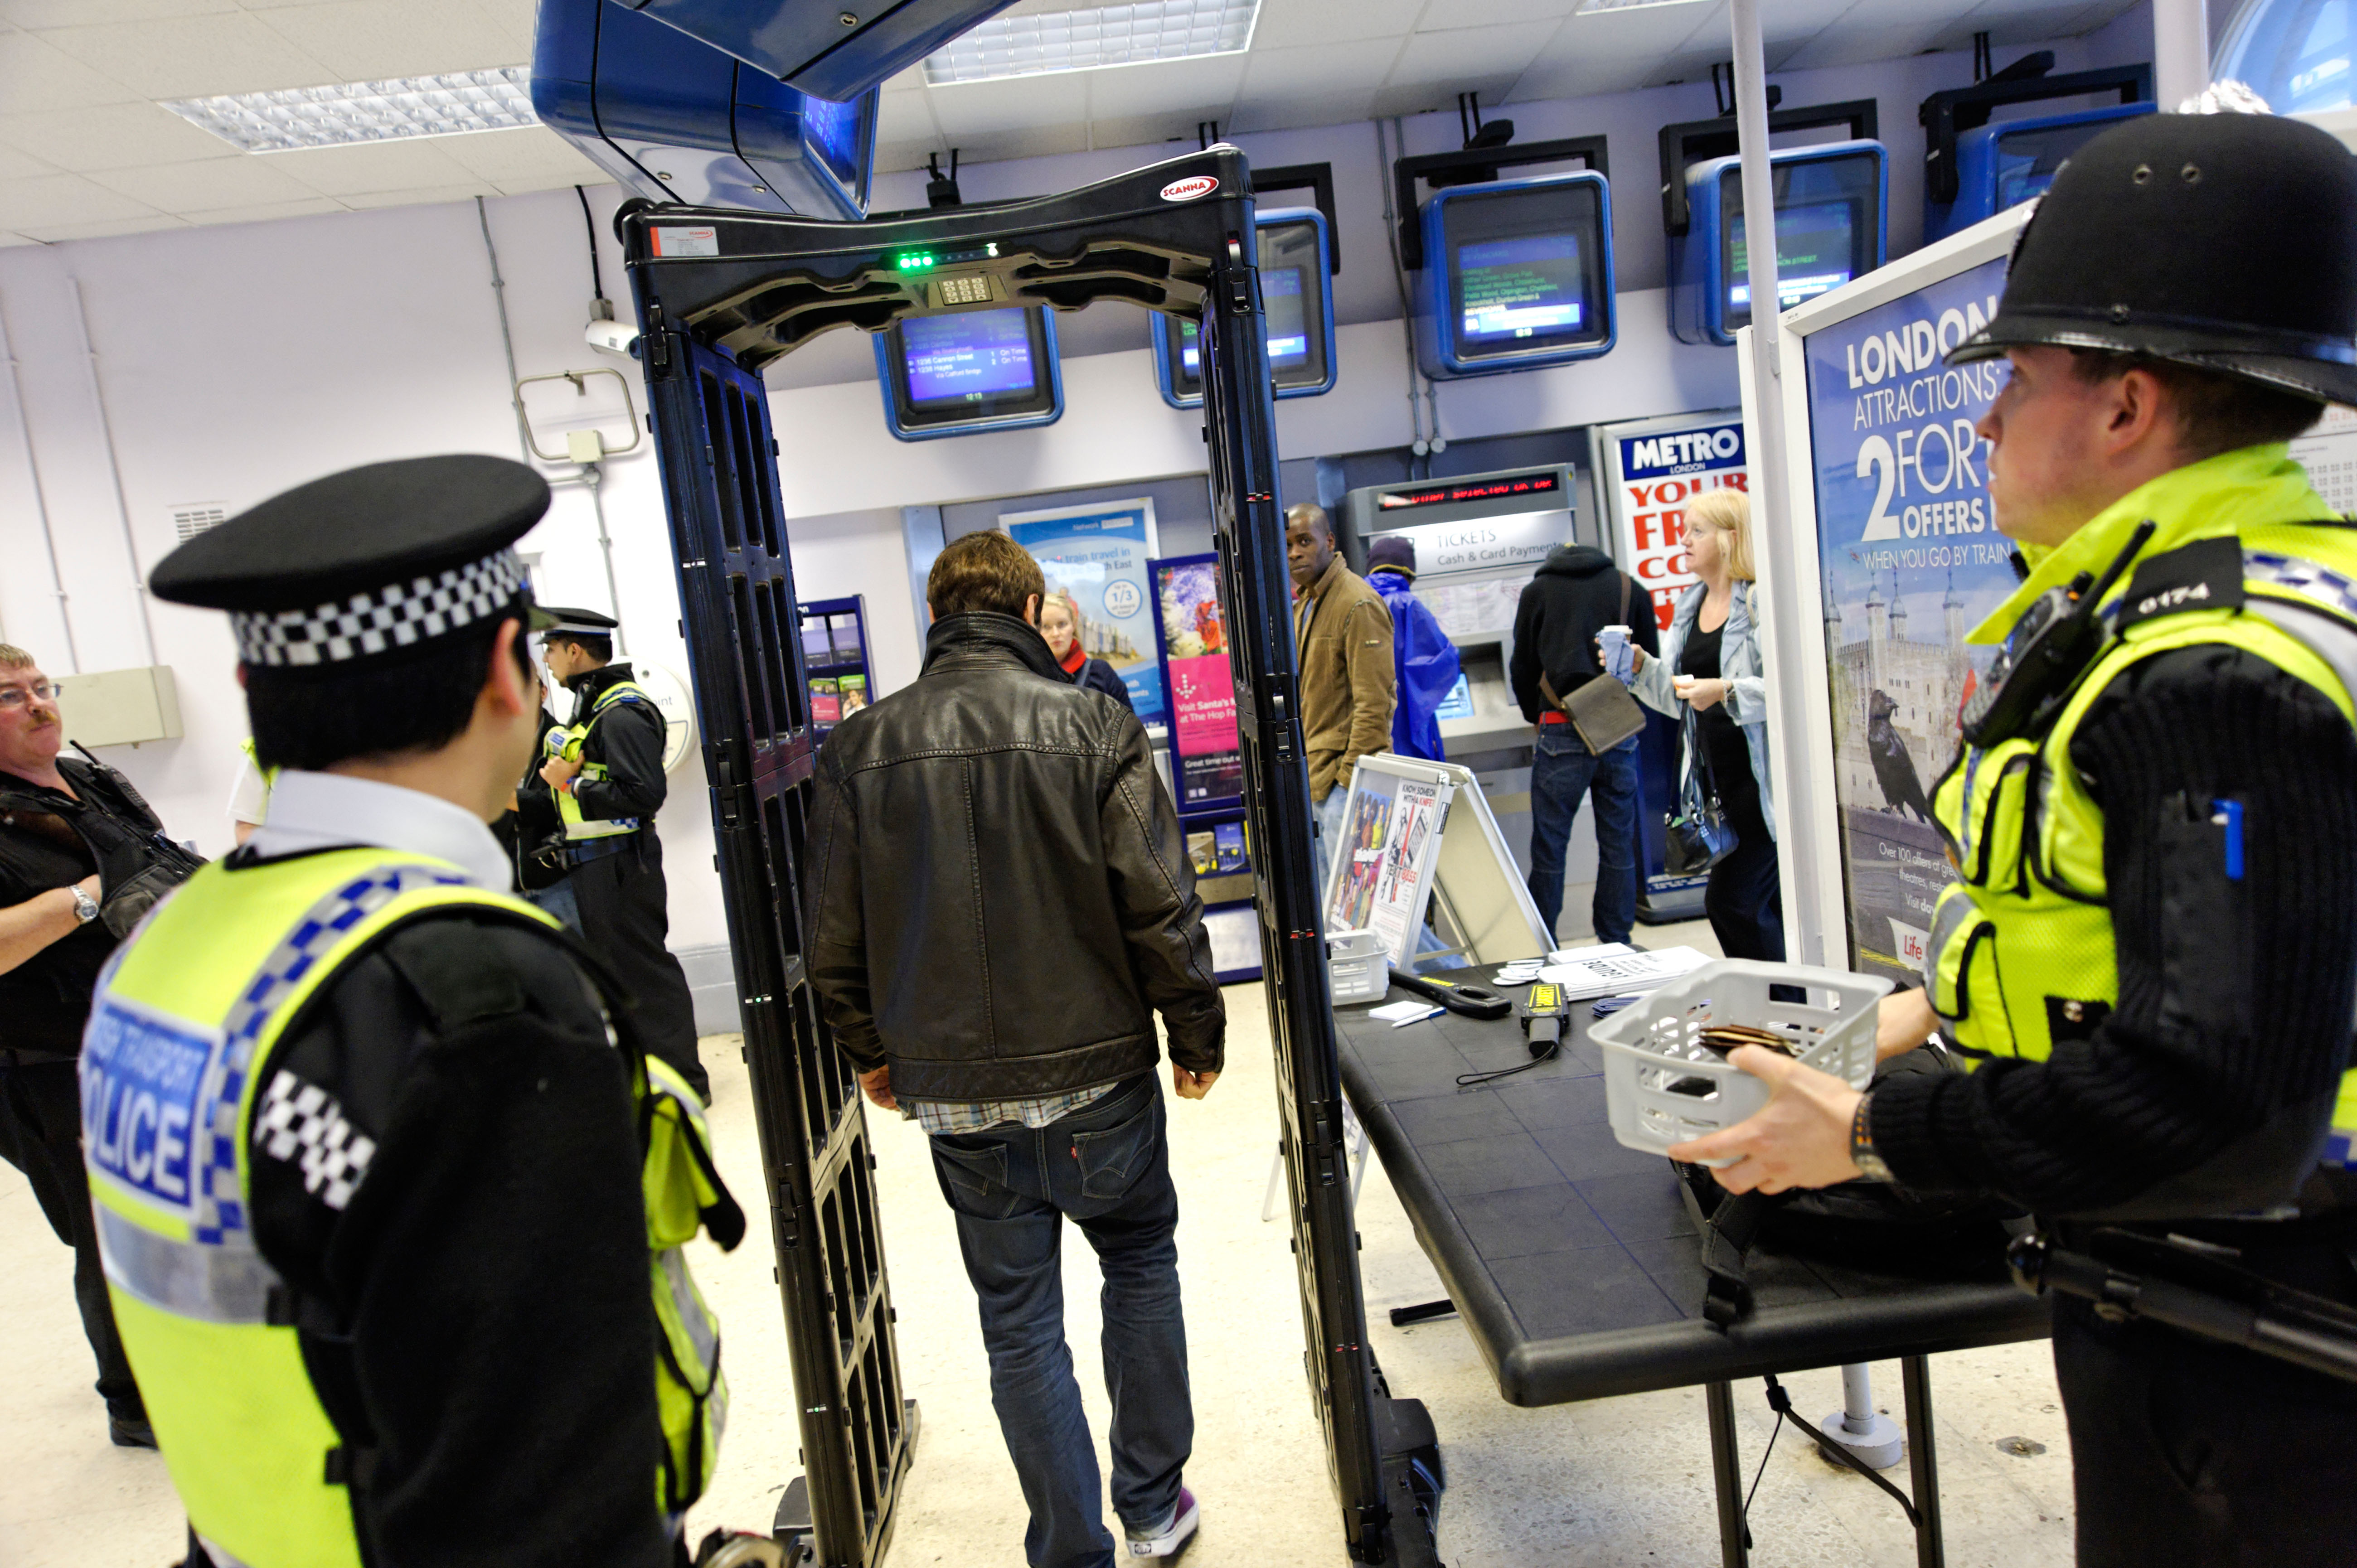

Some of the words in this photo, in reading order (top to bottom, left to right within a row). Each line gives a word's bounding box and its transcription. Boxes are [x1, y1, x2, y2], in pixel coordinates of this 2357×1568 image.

[1164, 182, 1206, 196] SCANNA
[1853, 361, 2002, 431] ATTRACTIONS:
[1633, 428, 1740, 471] METRO
[1669, 462, 1706, 475] LONDON
[1857, 435, 1901, 542] 2
[1896, 418, 1981, 497] FOR
[1903, 498, 1985, 539] OFFERS
[1437, 528, 1497, 548] TICKETS
[1633, 509, 1686, 551] FR
[1066, 554, 1088, 563] train
[1091, 547, 1119, 560] travel
[1121, 547, 1131, 557] in
[1114, 560, 1133, 570] East
[1438, 551, 1465, 566] Cash
[1469, 551, 1476, 561] &
[1480, 547, 1506, 560] Card
[1862, 549, 1898, 570] WHEN
[1901, 548, 1926, 568] YOU
[1929, 547, 1951, 567] GO
[1954, 545, 1968, 565] BY
[1637, 553, 1692, 579] CO
[1111, 589, 1133, 603] 1/3
[1178, 702, 1196, 712] Visit
[1197, 698, 1229, 710] Santa's
[1179, 715, 1188, 724] at
[1189, 712, 1206, 721] The
[1207, 710, 1226, 720] Hop
[1184, 759, 1204, 769] Great
[1205, 757, 1222, 766] time
[1416, 786, 1436, 798] SOMEON
[1879, 842, 1896, 859] Over
[1898, 847, 1911, 862] 100
[1912, 852, 1932, 869] offers
[1933, 862, 1940, 872] at
[1941, 864, 1957, 878] gre
[1899, 866, 1928, 890] theatres,
[1905, 892, 1920, 909] Visit
[1904, 934, 1923, 961] Life
[82, 1065, 189, 1197] OLICE
